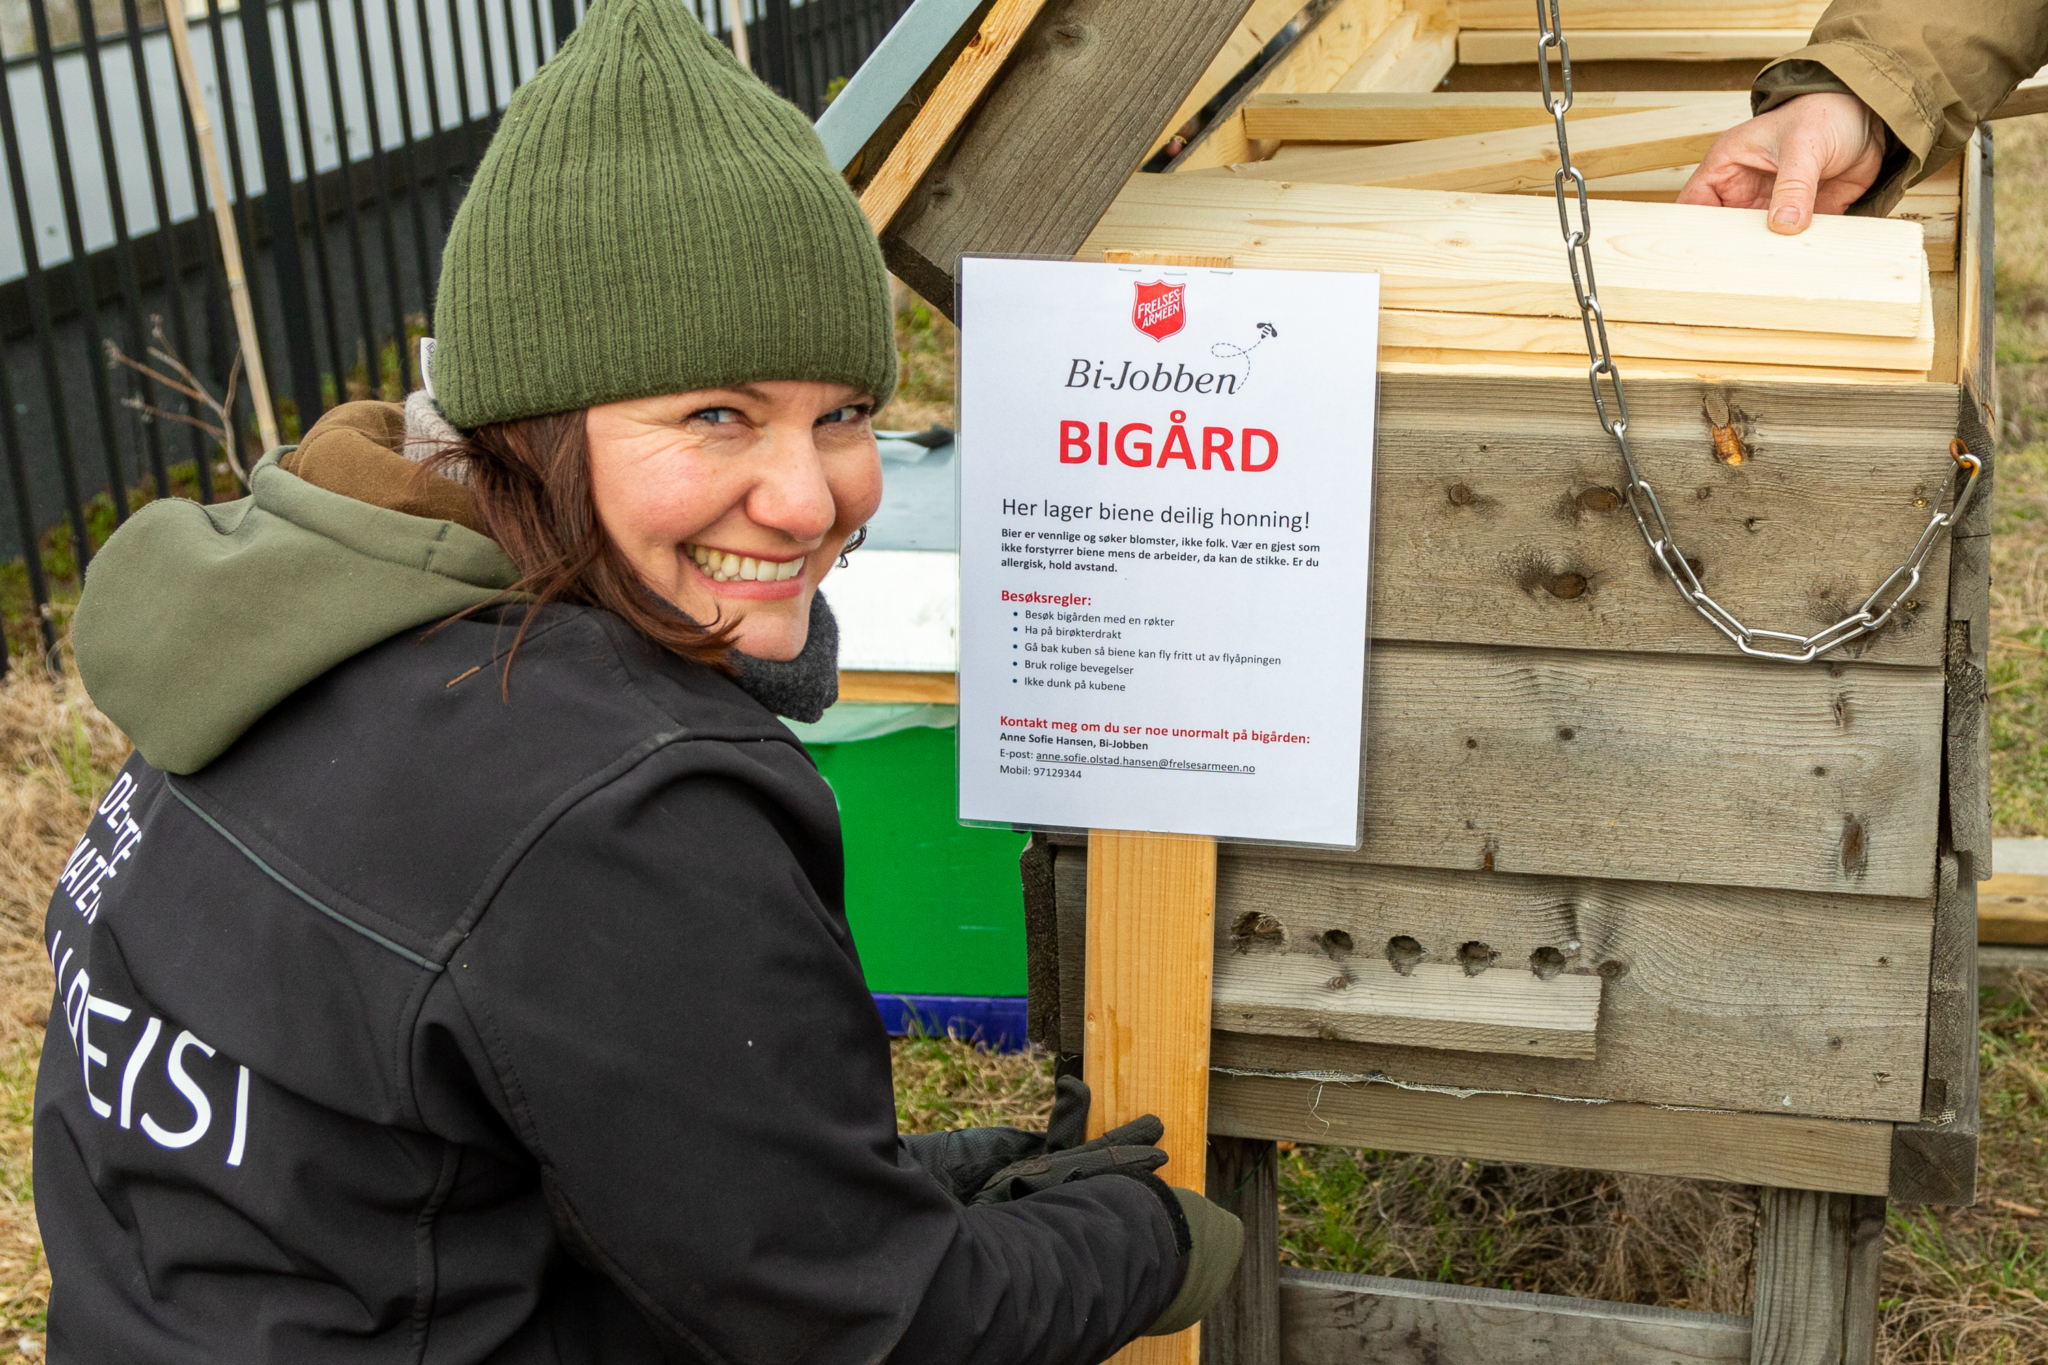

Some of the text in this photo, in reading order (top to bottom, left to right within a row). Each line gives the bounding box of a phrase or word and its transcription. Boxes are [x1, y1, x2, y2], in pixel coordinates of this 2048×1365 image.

[1141, 301, 1180, 329] ARMEEN
[1064, 357, 1237, 395] Bi-Jobben
[1059, 409, 1279, 473] BIGÅRD
[1003, 498, 1309, 533] Her lager biene deilig honning!
[1001, 528, 1022, 538] Bier
[1037, 531, 1081, 543] vennlige
[1083, 534, 1096, 544] og
[1099, 533, 1127, 543] søker
[1130, 534, 1179, 547] blomster,
[1181, 537, 1203, 547] ikke
[1205, 538, 1228, 548] folk.
[1231, 539, 1253, 549] Vær
[1255, 542, 1268, 550] en
[1271, 541, 1296, 553] gjest
[1298, 544, 1320, 552] som
[1001, 543, 1319, 567] ikke forstyrrer biene mens de arbeider, da kan de stikke. Er du
[1001, 557, 1118, 572] allergisk, hold avstand.
[1001, 590, 1091, 607] Besøksregler:
[1025, 610, 1054, 620] Besøk
[1057, 611, 1101, 623] bigården
[1104, 615, 1126, 624] med
[1144, 617, 1175, 627] røkter
[1025, 625, 1121, 639] Ha på birøkterdrakt
[1024, 642, 1281, 666] Gå bak kuben så biene kan fly fritt ut av flyåpningen
[1025, 660, 1134, 675] Bruk rolige bevegelser
[1024, 677, 1126, 692] Ikke dunk på kubene
[999, 732, 1148, 750] Anne Sofie Hansen, Bi-Jobben
[1000, 716, 1310, 744] Kontakt meg om du ser noe unormalt på bigården:
[1000, 748, 1256, 775] E-post: anne.sofie.olstad.hansen@frelsesarmeen.no
[1000, 765, 1082, 778] Mobil: 97129344
